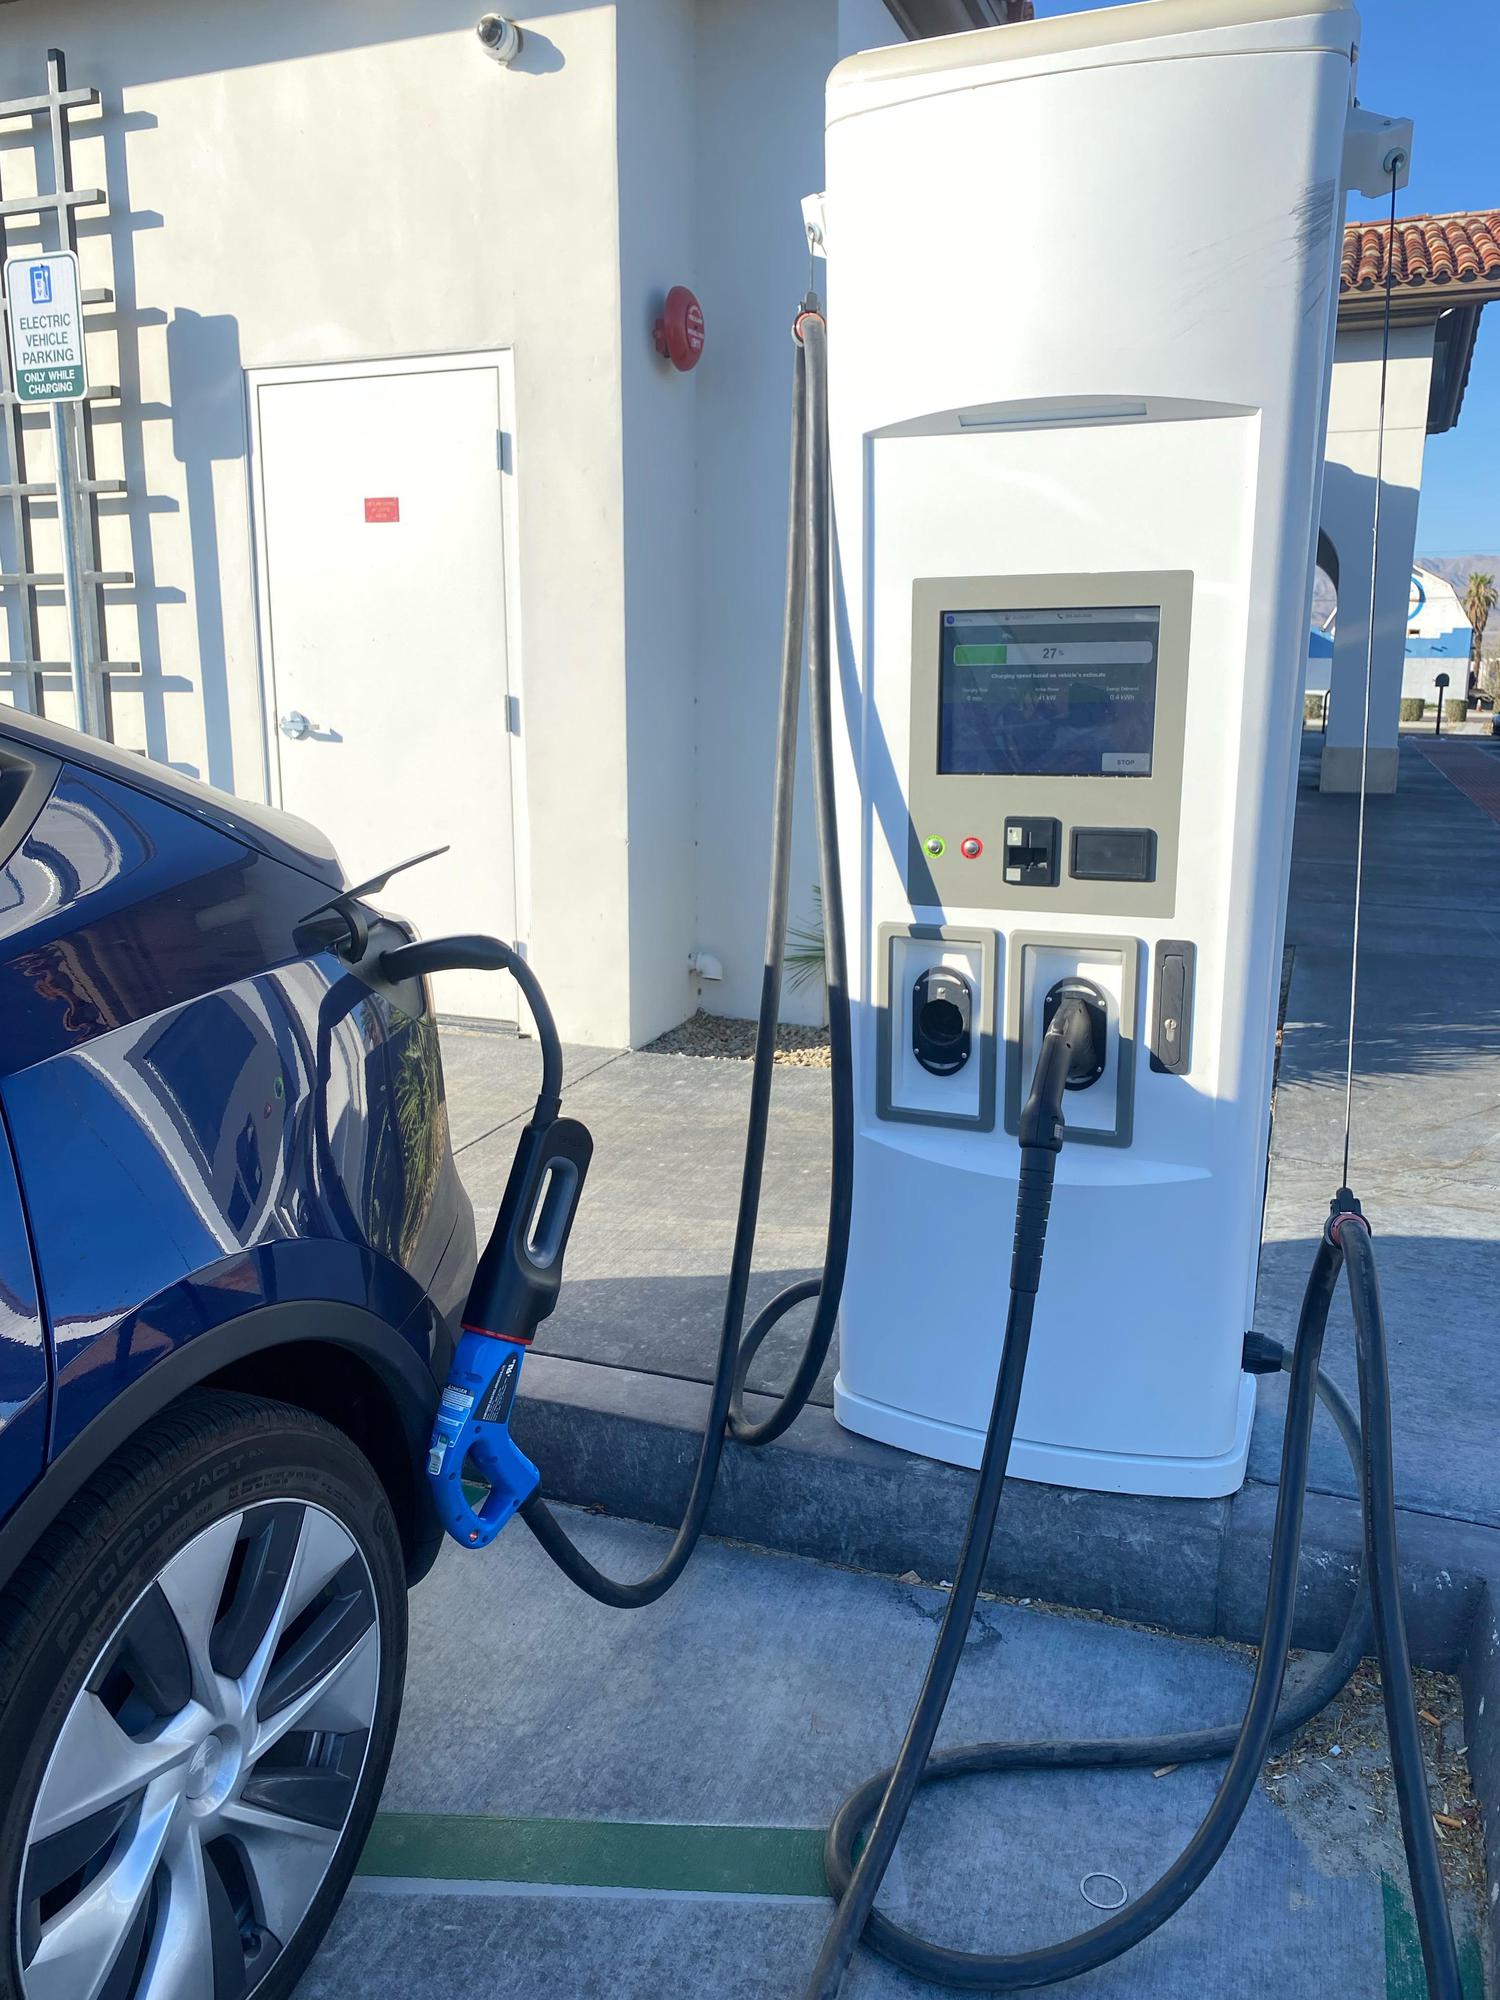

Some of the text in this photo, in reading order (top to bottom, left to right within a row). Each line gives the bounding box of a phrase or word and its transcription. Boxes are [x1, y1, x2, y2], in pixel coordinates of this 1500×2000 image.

[20, 313, 71, 330] ELECTRIC
[25, 331, 69, 347] VEHICLE
[22, 348, 74, 365] PARKING
[24, 369, 75, 383] ONLY WHILE
[28, 382, 73, 395] CHARGING
[1043, 647, 1057, 659] 27
